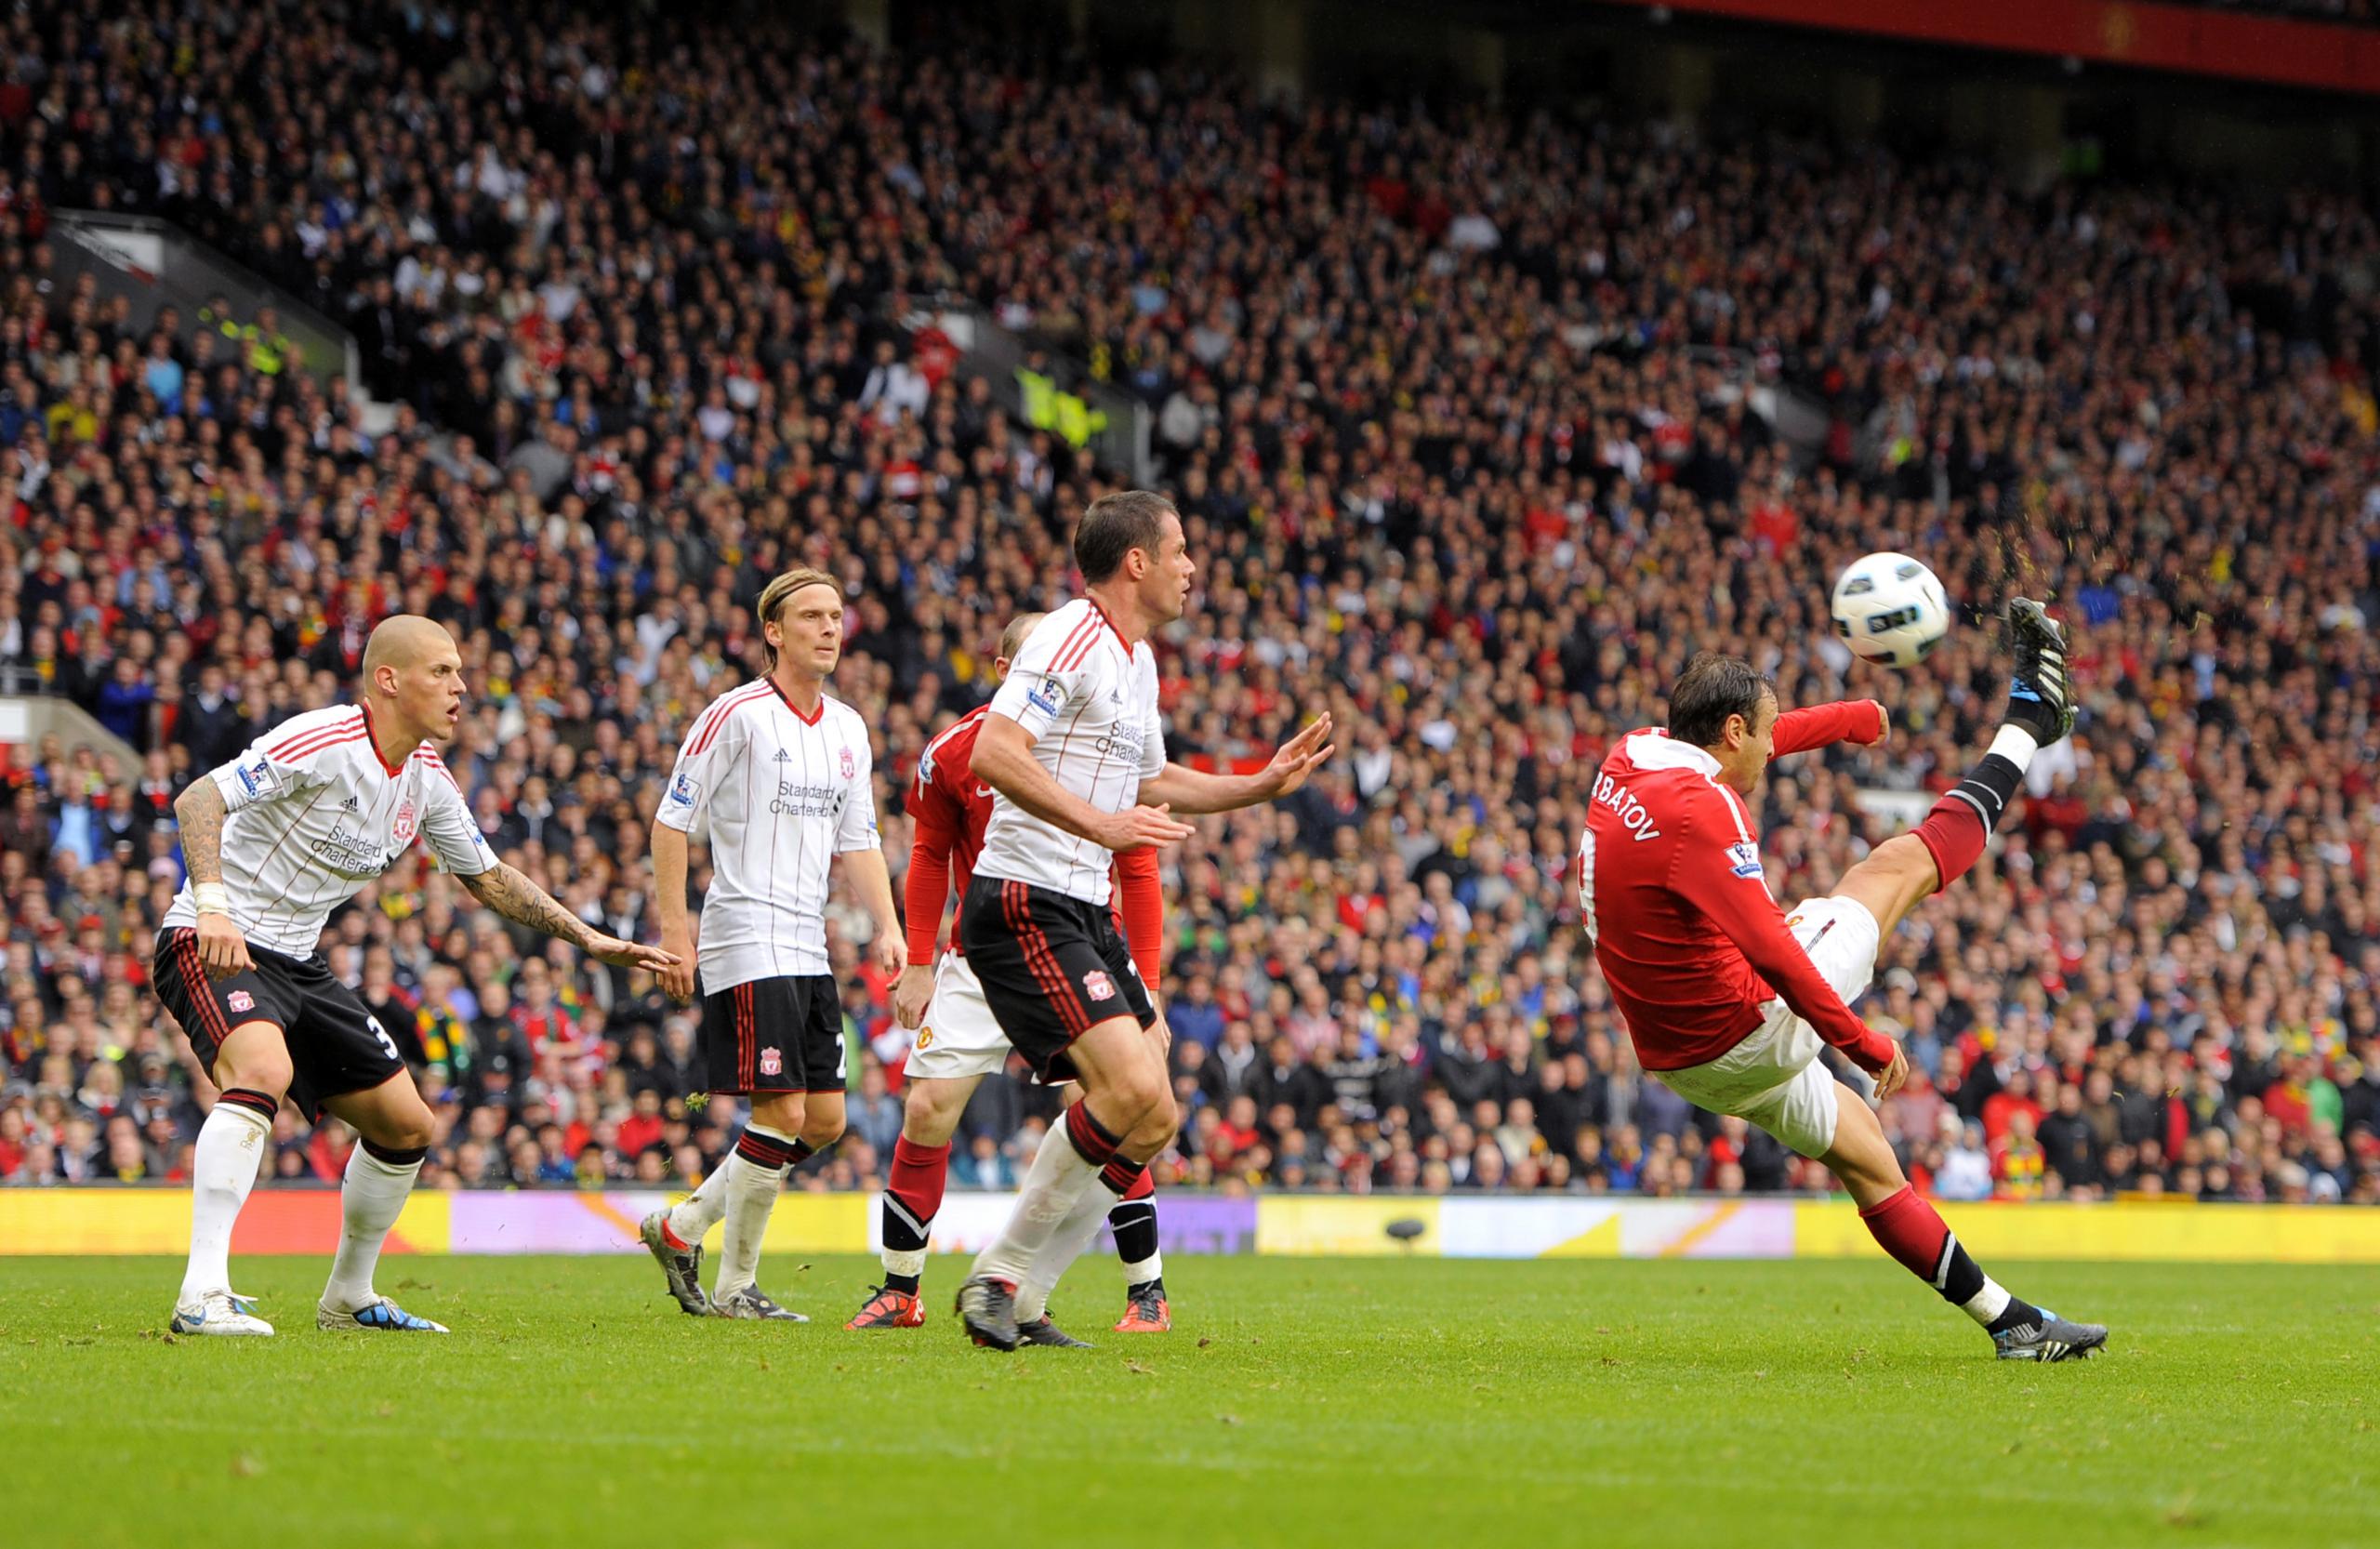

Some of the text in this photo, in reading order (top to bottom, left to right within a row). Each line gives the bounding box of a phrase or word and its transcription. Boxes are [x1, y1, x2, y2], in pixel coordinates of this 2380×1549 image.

[779, 781, 835, 800] Standard
[770, 799, 829, 817] Chartered
[311, 839, 380, 875] Chartered
[329, 826, 382, 858] Standard
[366, 1014, 398, 1060] 3
